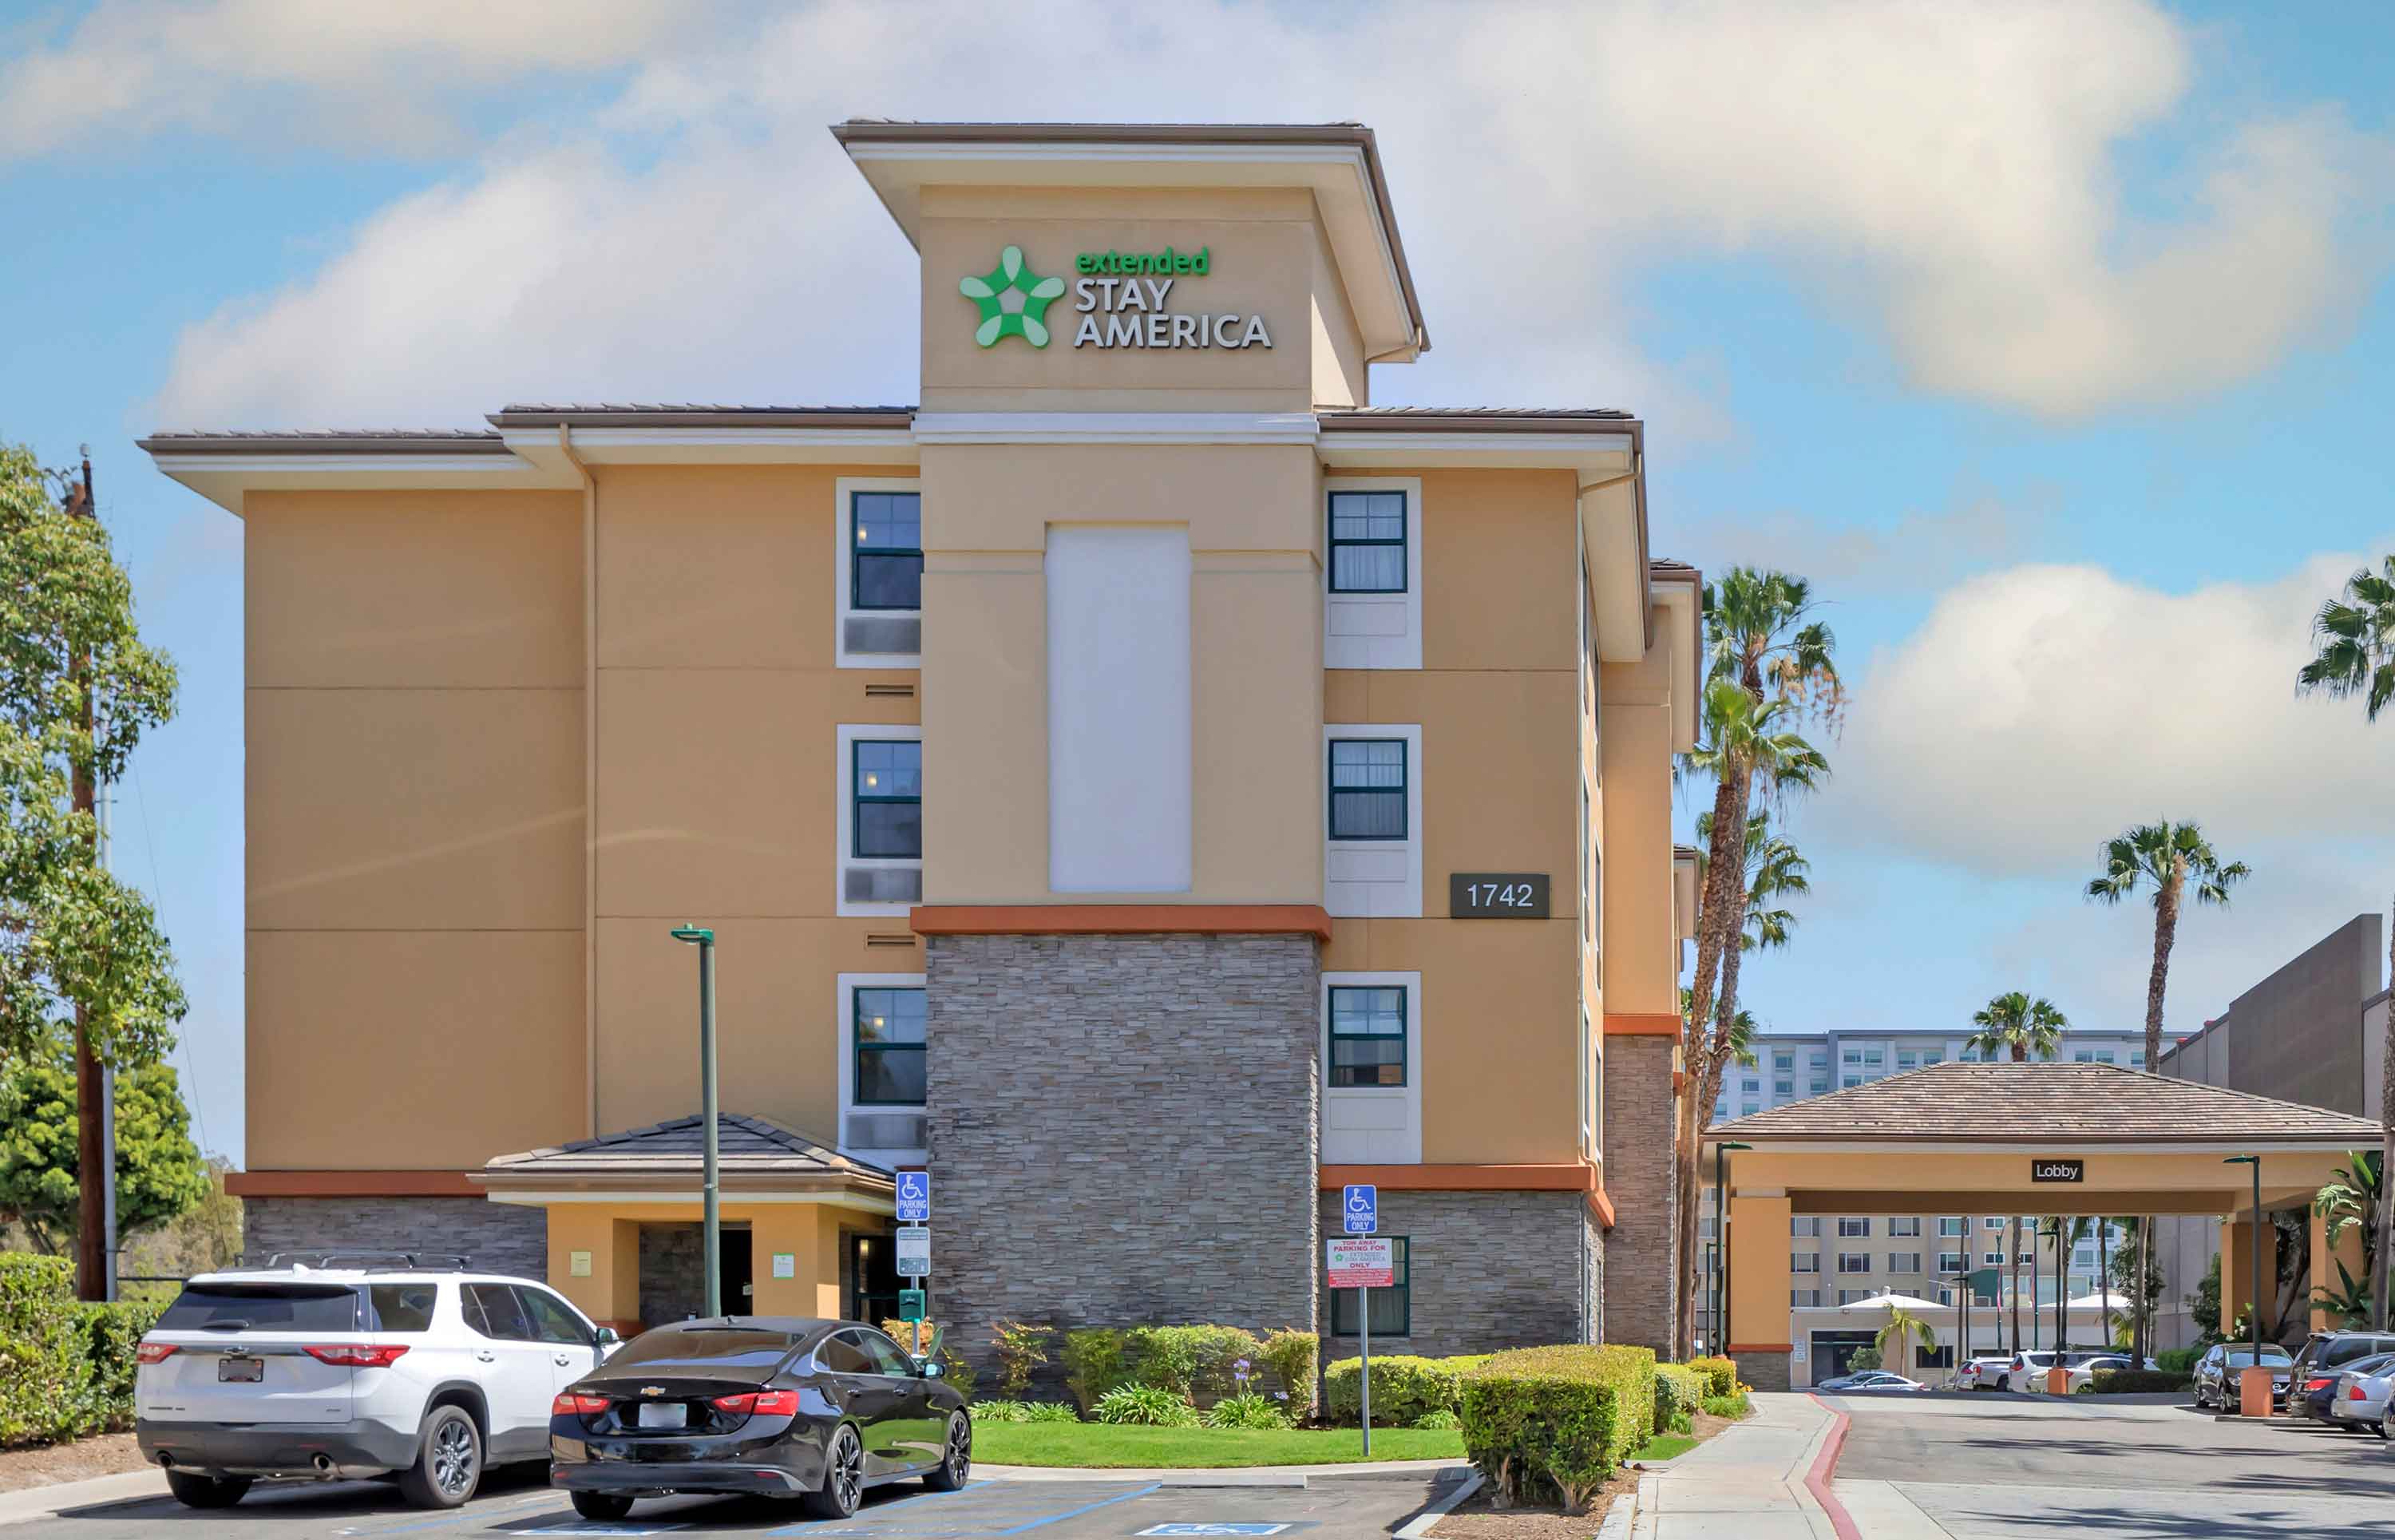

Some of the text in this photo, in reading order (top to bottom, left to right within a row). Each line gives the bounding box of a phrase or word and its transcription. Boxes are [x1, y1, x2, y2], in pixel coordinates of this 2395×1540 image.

[1075, 247, 1209, 275] extended
[1075, 278, 1174, 313] STAY
[1074, 315, 1273, 349] AMERICA
[1467, 883, 1534, 907] 1742
[2037, 1164, 2079, 1180] Lobby
[899, 1200, 927, 1209] PARKING
[904, 1209, 921, 1217] ONLY
[1347, 1213, 1375, 1221] PARKING
[1352, 1221, 1370, 1230] ONLY
